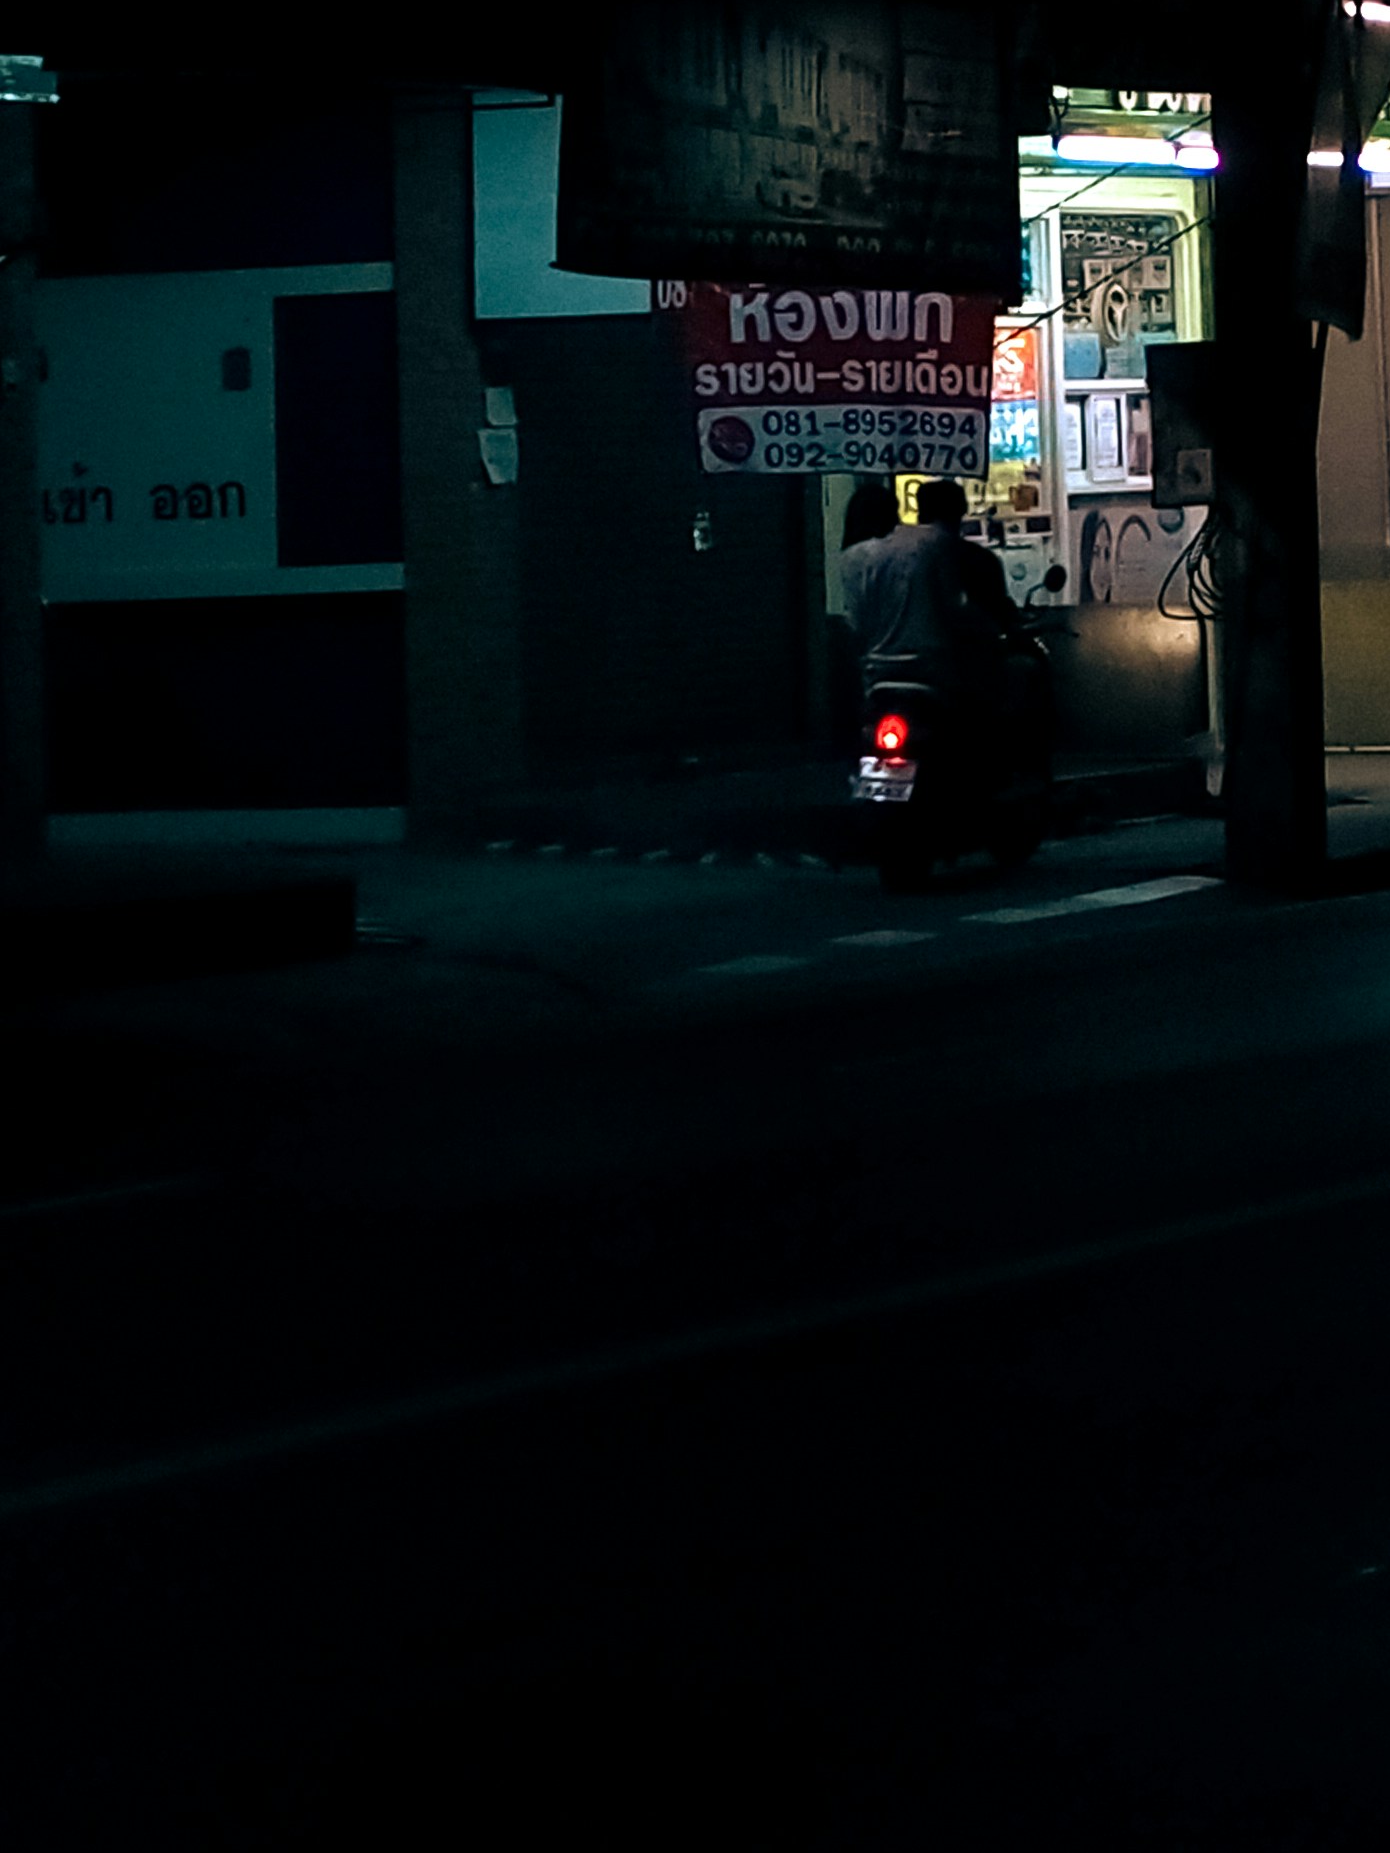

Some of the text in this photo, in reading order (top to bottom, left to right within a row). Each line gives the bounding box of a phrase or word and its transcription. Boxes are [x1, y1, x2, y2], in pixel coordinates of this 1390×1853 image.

[729, 284, 954, 344] หองพก
[762, 409, 977, 438] 081-8952694
[764, 440, 978, 470] 092-9040770
[149, 481, 245, 520] ออก
